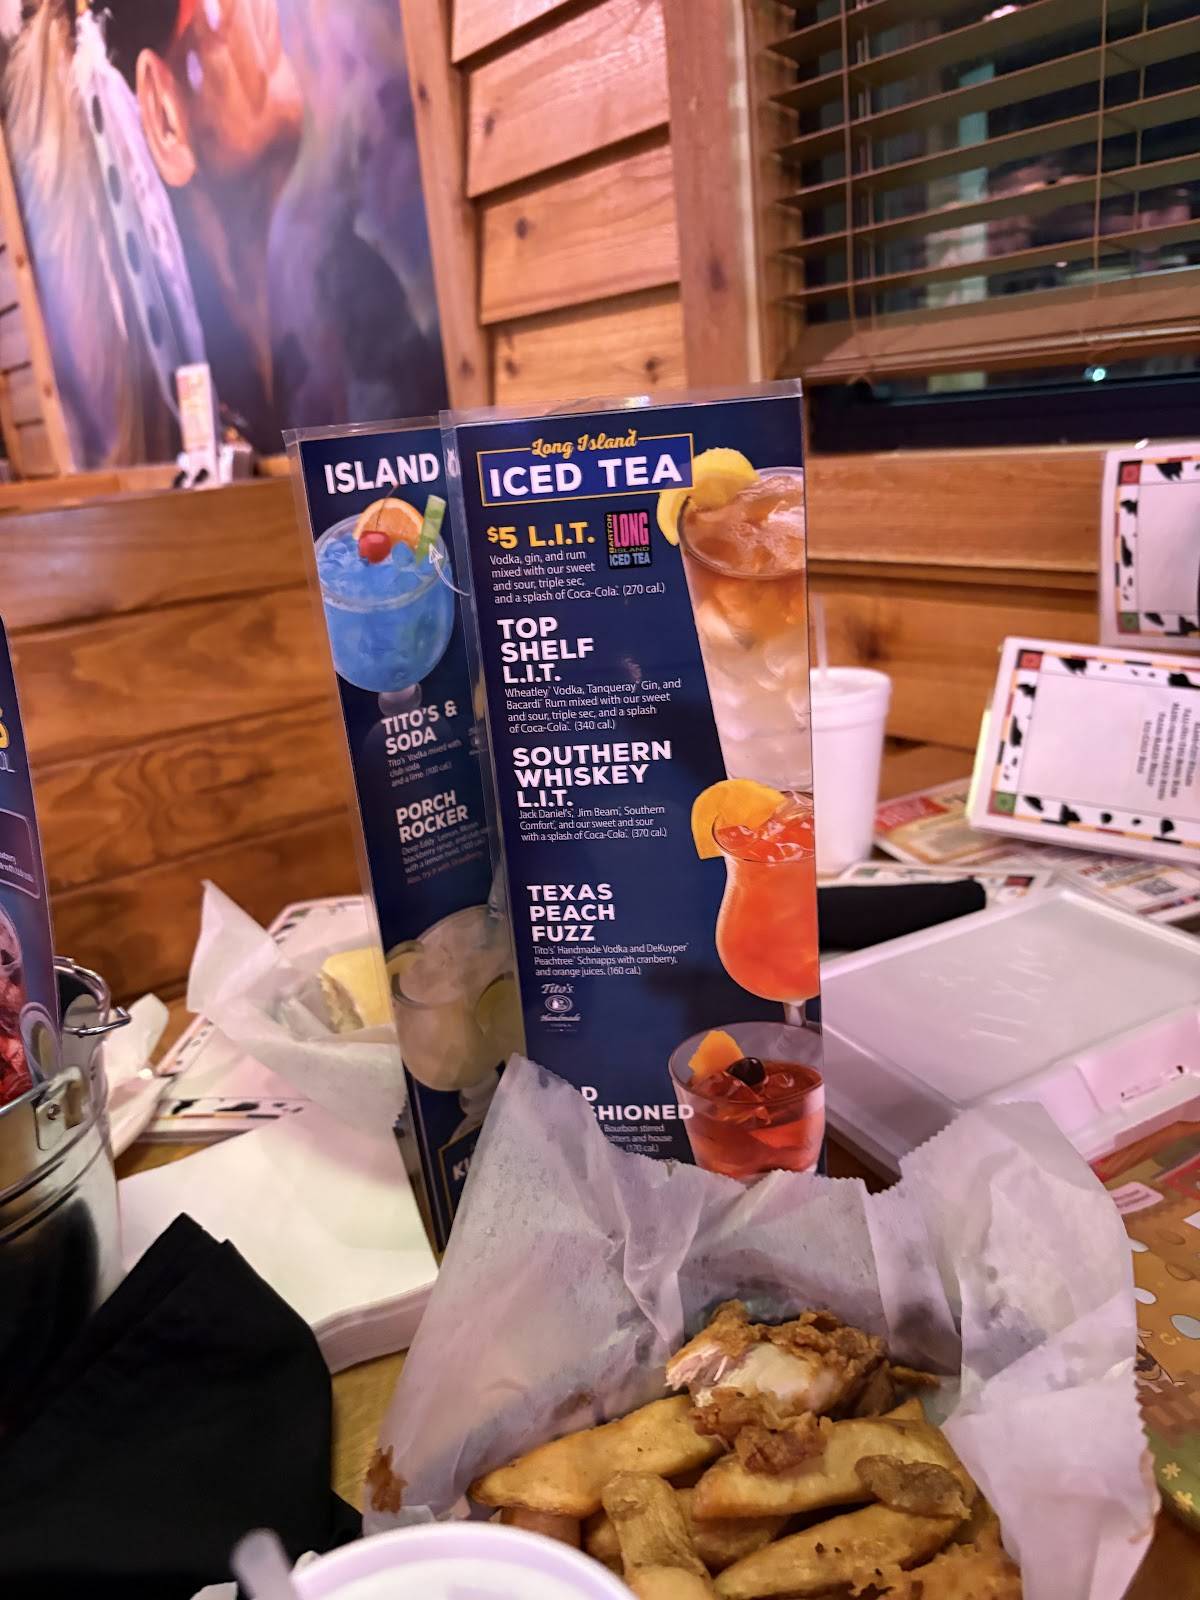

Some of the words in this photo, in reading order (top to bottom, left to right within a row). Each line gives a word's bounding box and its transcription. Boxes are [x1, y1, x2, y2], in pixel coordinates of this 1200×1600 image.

[532, 438, 573, 459] Long
[577, 428, 637, 451] Island
[324, 453, 440, 495] ISLAND
[489, 462, 582, 497] ICED
[598, 454, 682, 487] TEA
[487, 526, 518, 549] $5
[528, 522, 596, 547] L.I.T.
[606, 514, 614, 553] BARTON
[612, 512, 650, 547] LONG
[490, 554, 522, 565] Vodka,
[524, 553, 542, 566] gin,
[545, 550, 563, 562] and
[566, 550, 586, 561] rum
[609, 553, 630, 567] ICED
[632, 551, 651, 564] TEA
[491, 566, 521, 578] mixed
[523, 564, 545, 576] with
[547, 565, 564, 575] our
[566, 562, 596, 573] sweet
[493, 580, 511, 591] and
[513, 580, 536, 590] sour,
[538, 577, 564, 589] triple
[566, 577, 585, 587] sec,
[494, 592, 513, 604] and
[522, 591, 553, 604] splash
[555, 589, 566, 600] of
[622, 584, 643, 597] (270
[645, 582, 665, 594] cal.)
[497, 616, 558, 639] TOP
[501, 637, 594, 663] SHELF
[502, 663, 562, 684] L.I.T.
[552, 685, 585, 695] Vodka,
[641, 681, 660, 691] Gin,
[663, 678, 681, 689] and
[545, 697, 567, 708] Rum
[568, 695, 598, 707] mixed
[599, 695, 621, 706] with
[623, 695, 640, 705] our
[641, 692, 671, 703] sweet
[381, 705, 440, 735] TITO'S
[445, 700, 458, 718] &
[507, 711, 525, 722] and
[527, 711, 551, 721] sour,
[552, 708, 577, 721] triple
[578, 708, 596, 718] sec,
[598, 706, 616, 717] and
[626, 705, 657, 718] splash
[509, 723, 520, 734] of
[574, 720, 595, 732] (340
[597, 719, 616, 730] cal.)
[386, 726, 437, 755] SODA
[512, 740, 672, 766] SOUTHERN
[513, 763, 650, 788] WHISKEY
[396, 789, 457, 825] PORCH
[516, 789, 574, 808] L.I.T.
[519, 809, 537, 819] Jack
[577, 807, 592, 818] Jim
[624, 804, 665, 816] Southern
[399, 805, 469, 843] ROCKER
[558, 818, 575, 829] and
[576, 820, 591, 828] our
[591, 817, 616, 828] sweet
[617, 816, 634, 826] and
[635, 817, 654, 826] sour
[521, 831, 539, 842] with
[547, 829, 573, 842] splash
[574, 828, 584, 839] of
[631, 828, 649, 839] (370
[650, 827, 668, 838] cal.)
[527, 883, 614, 902] TEXAS
[529, 903, 616, 921] PEACH
[531, 924, 595, 942] FUZZ
[557, 945, 601, 955] Handmade
[601, 944, 628, 954] Vodka
[629, 943, 646, 954] and
[576, 956, 616, 968] Schnapps
[617, 954, 635, 964] with
[636, 953, 679, 965] cranberry,
[535, 967, 551, 977] and
[552, 967, 581, 978] orange
[607, 965, 624, 976] (160
[625, 965, 642, 976] cal.)
[591, 1104, 695, 1120] HIONED
